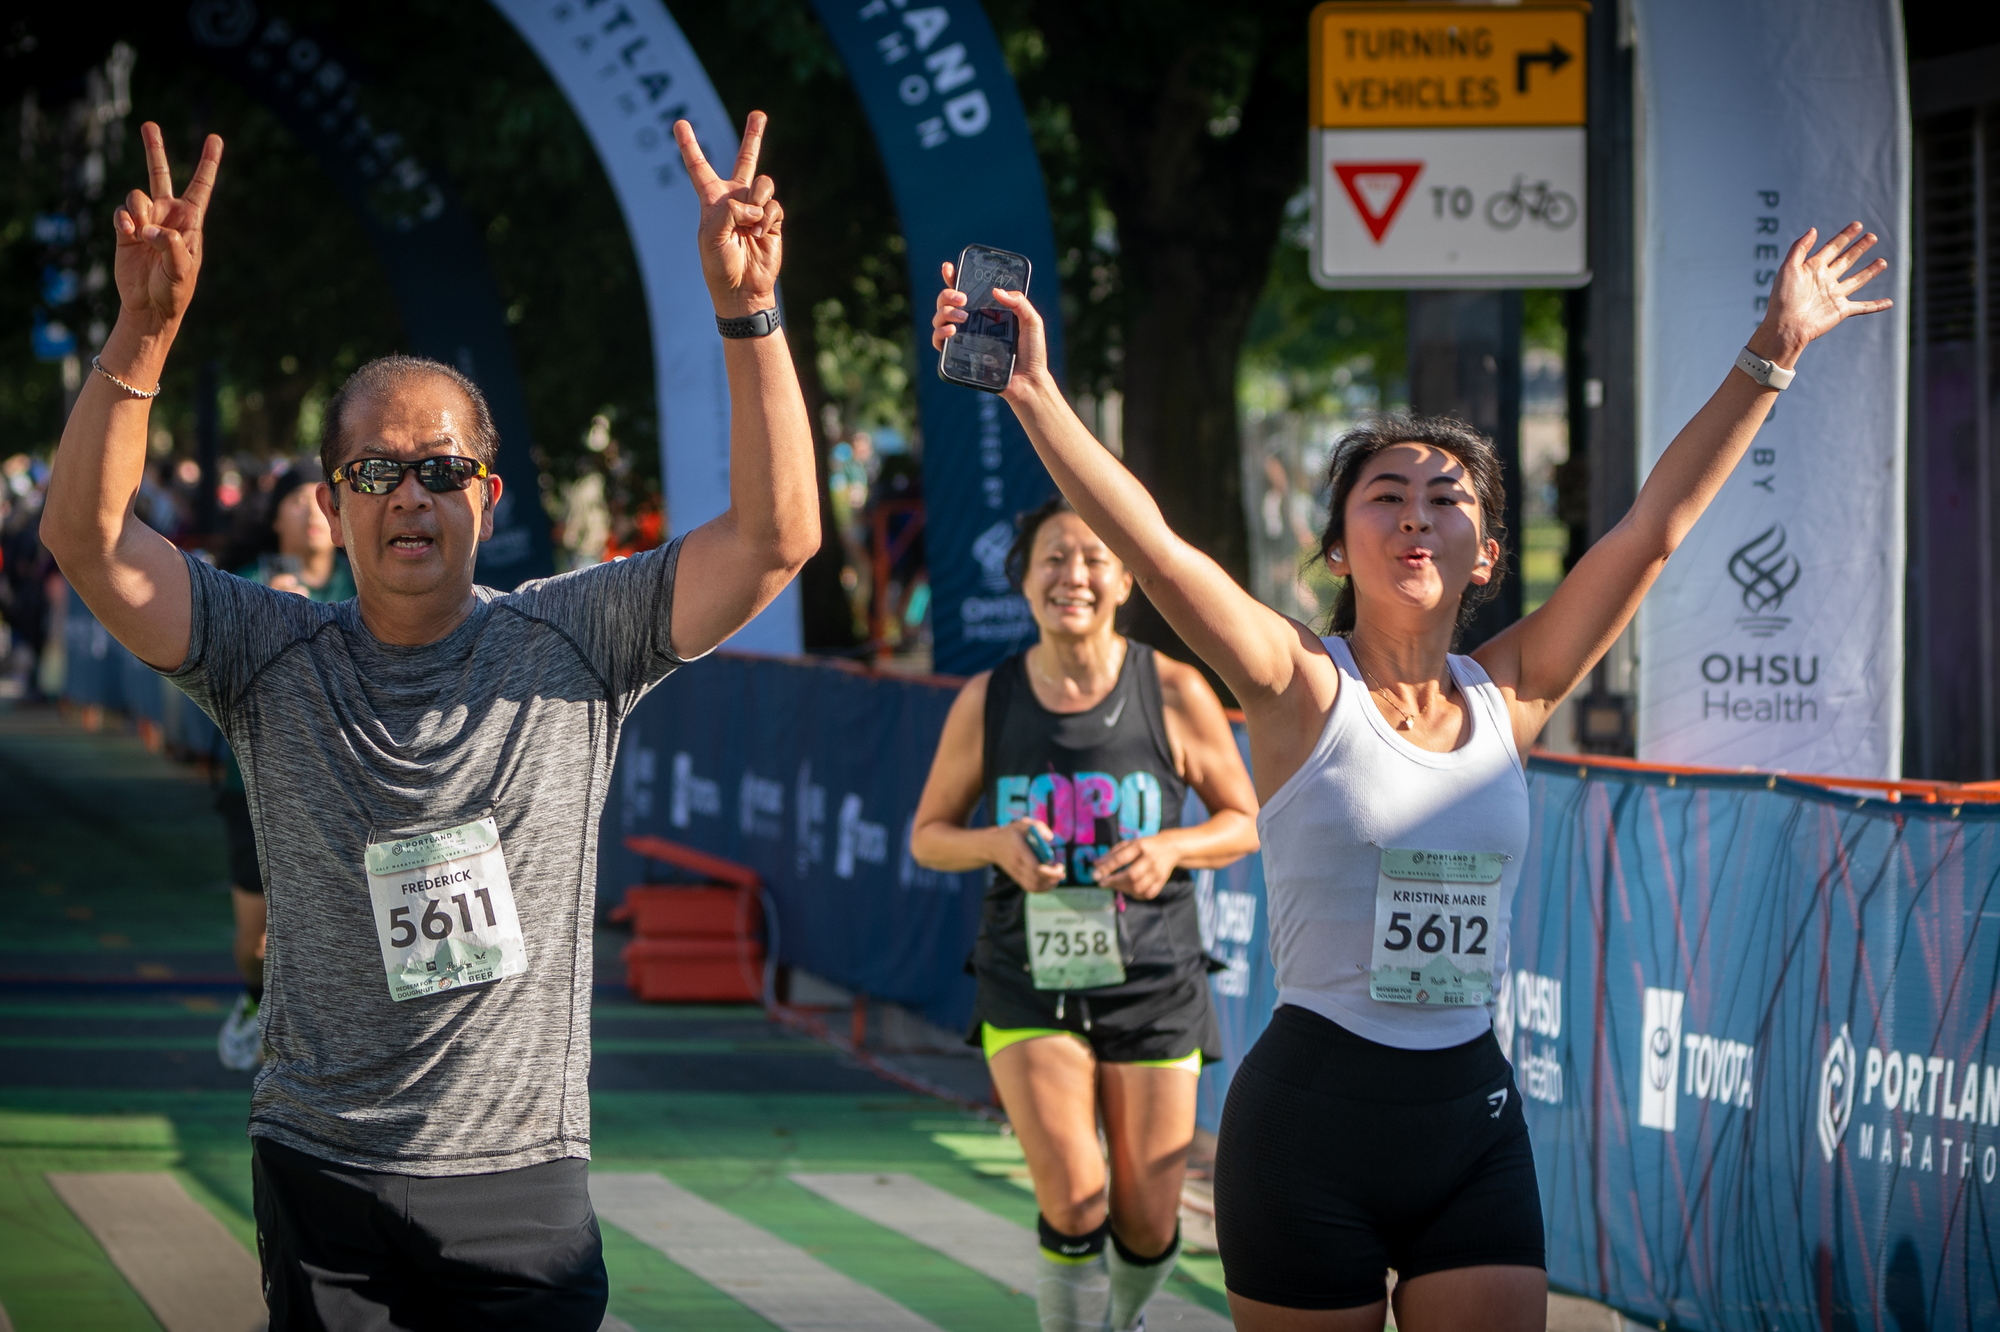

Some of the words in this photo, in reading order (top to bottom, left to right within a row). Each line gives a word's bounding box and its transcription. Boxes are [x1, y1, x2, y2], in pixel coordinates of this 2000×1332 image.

[1343, 27, 1495, 61] TURNING
[889, 0, 992, 138] AND
[1334, 76, 1501, 111] VEHICLES
[1430, 185, 1475, 220] TO
[974, 268, 1013, 288] 09:47
[1752, 448, 1776, 493] BY
[1701, 653, 1819, 686] OHSU
[1703, 688, 1818, 723] Health
[405, 832, 453, 849] PORTLAND
[1426, 853, 1468, 862] PORTLAND
[401, 869, 472, 896] FREDERICK
[1393, 889, 1449, 906] KRISTINE
[1452, 893, 1487, 906] MARIE
[390, 887, 497, 948] 5611
[1383, 911, 1489, 956] 5612
[1035, 931, 1110, 957] 7358
[395, 982, 419, 992] REDEEM
[420, 979, 433, 987] FOR
[397, 986, 434, 999] DOUGHNUT
[468, 971, 494, 983] BEER
[1444, 994, 1465, 1004] BEER
[1516, 968, 1563, 1040] OHSU
[1517, 1034, 1564, 1105] Health
[1684, 1032, 1754, 1110] TOYOTA
[1863, 1046, 2000, 1128] PORTLAN
[1858, 1122, 1997, 1184] MARATHO
